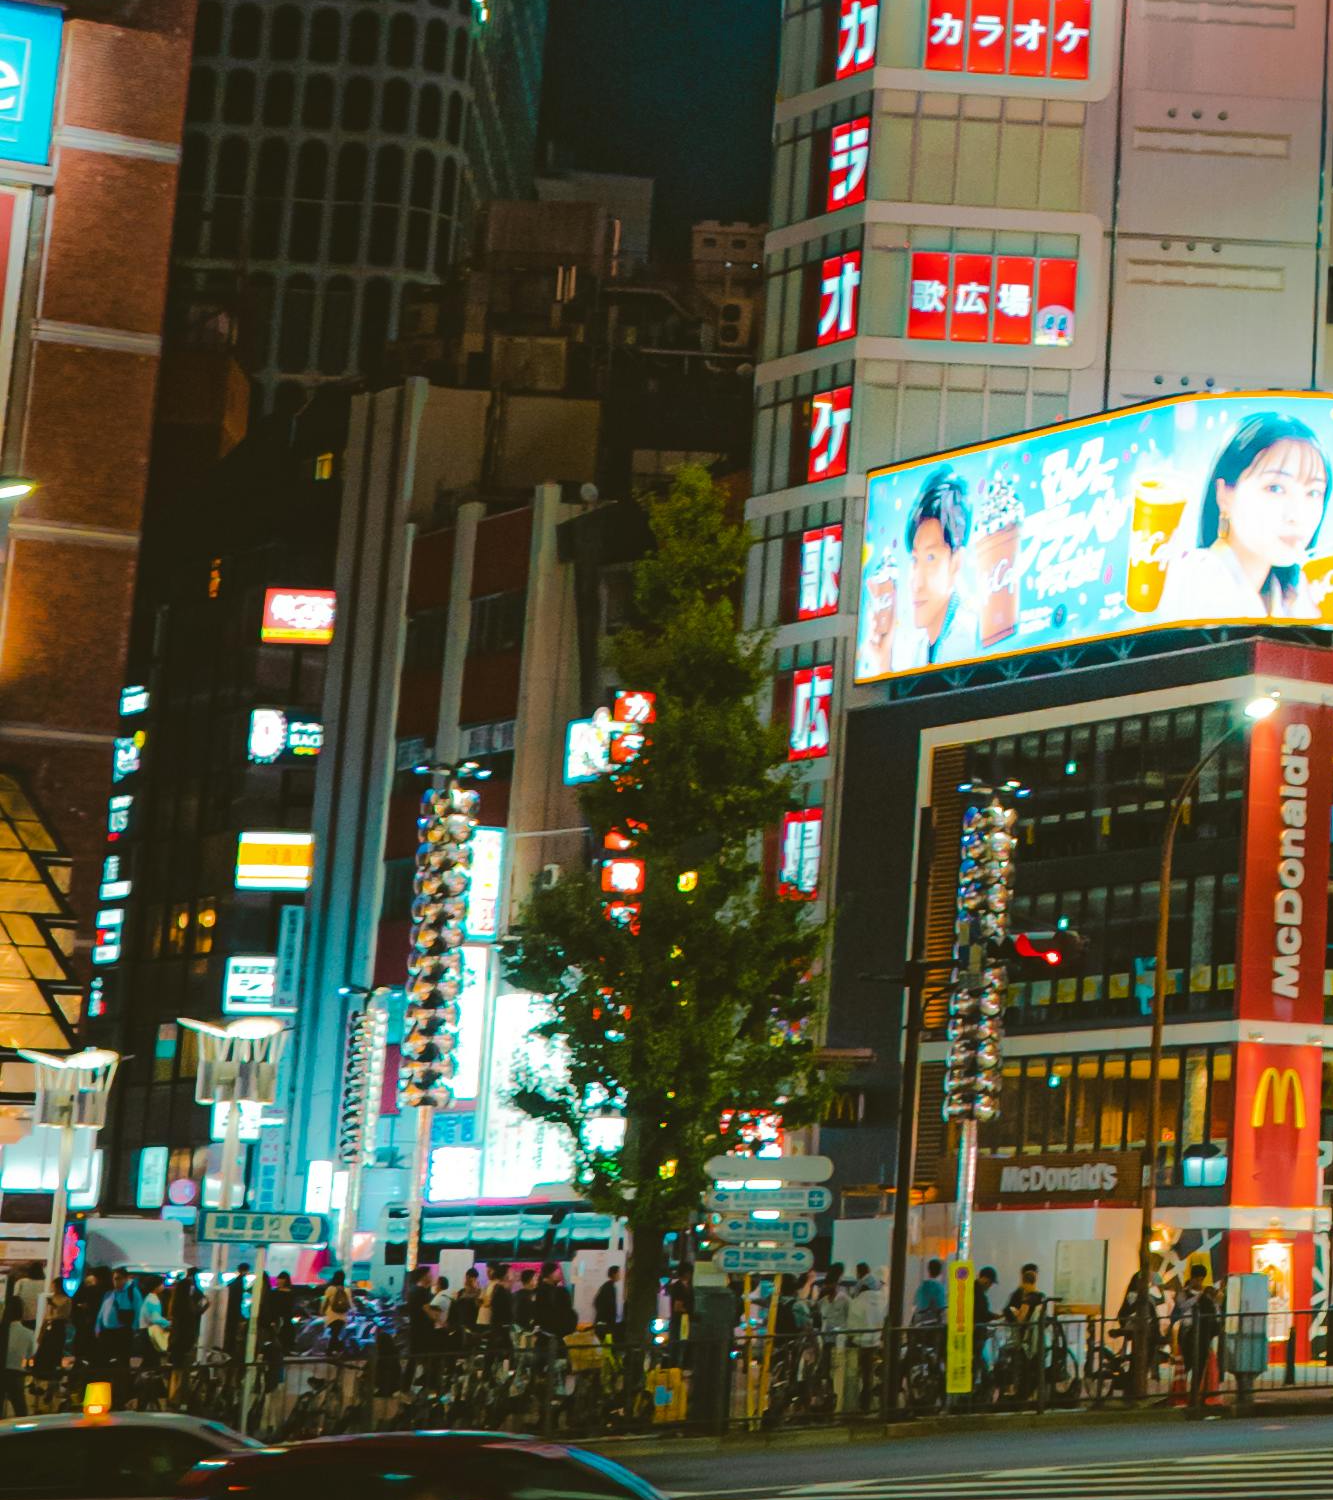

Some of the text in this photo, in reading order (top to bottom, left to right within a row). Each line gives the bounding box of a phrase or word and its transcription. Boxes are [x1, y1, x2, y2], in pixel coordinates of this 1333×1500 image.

[931, 13, 1089, 53] カラオケ
[912, 280, 1031, 317] 歌広場
[1271, 722, 1312, 999] McDonald's
[1001, 1163, 1117, 1193] McDonald's
